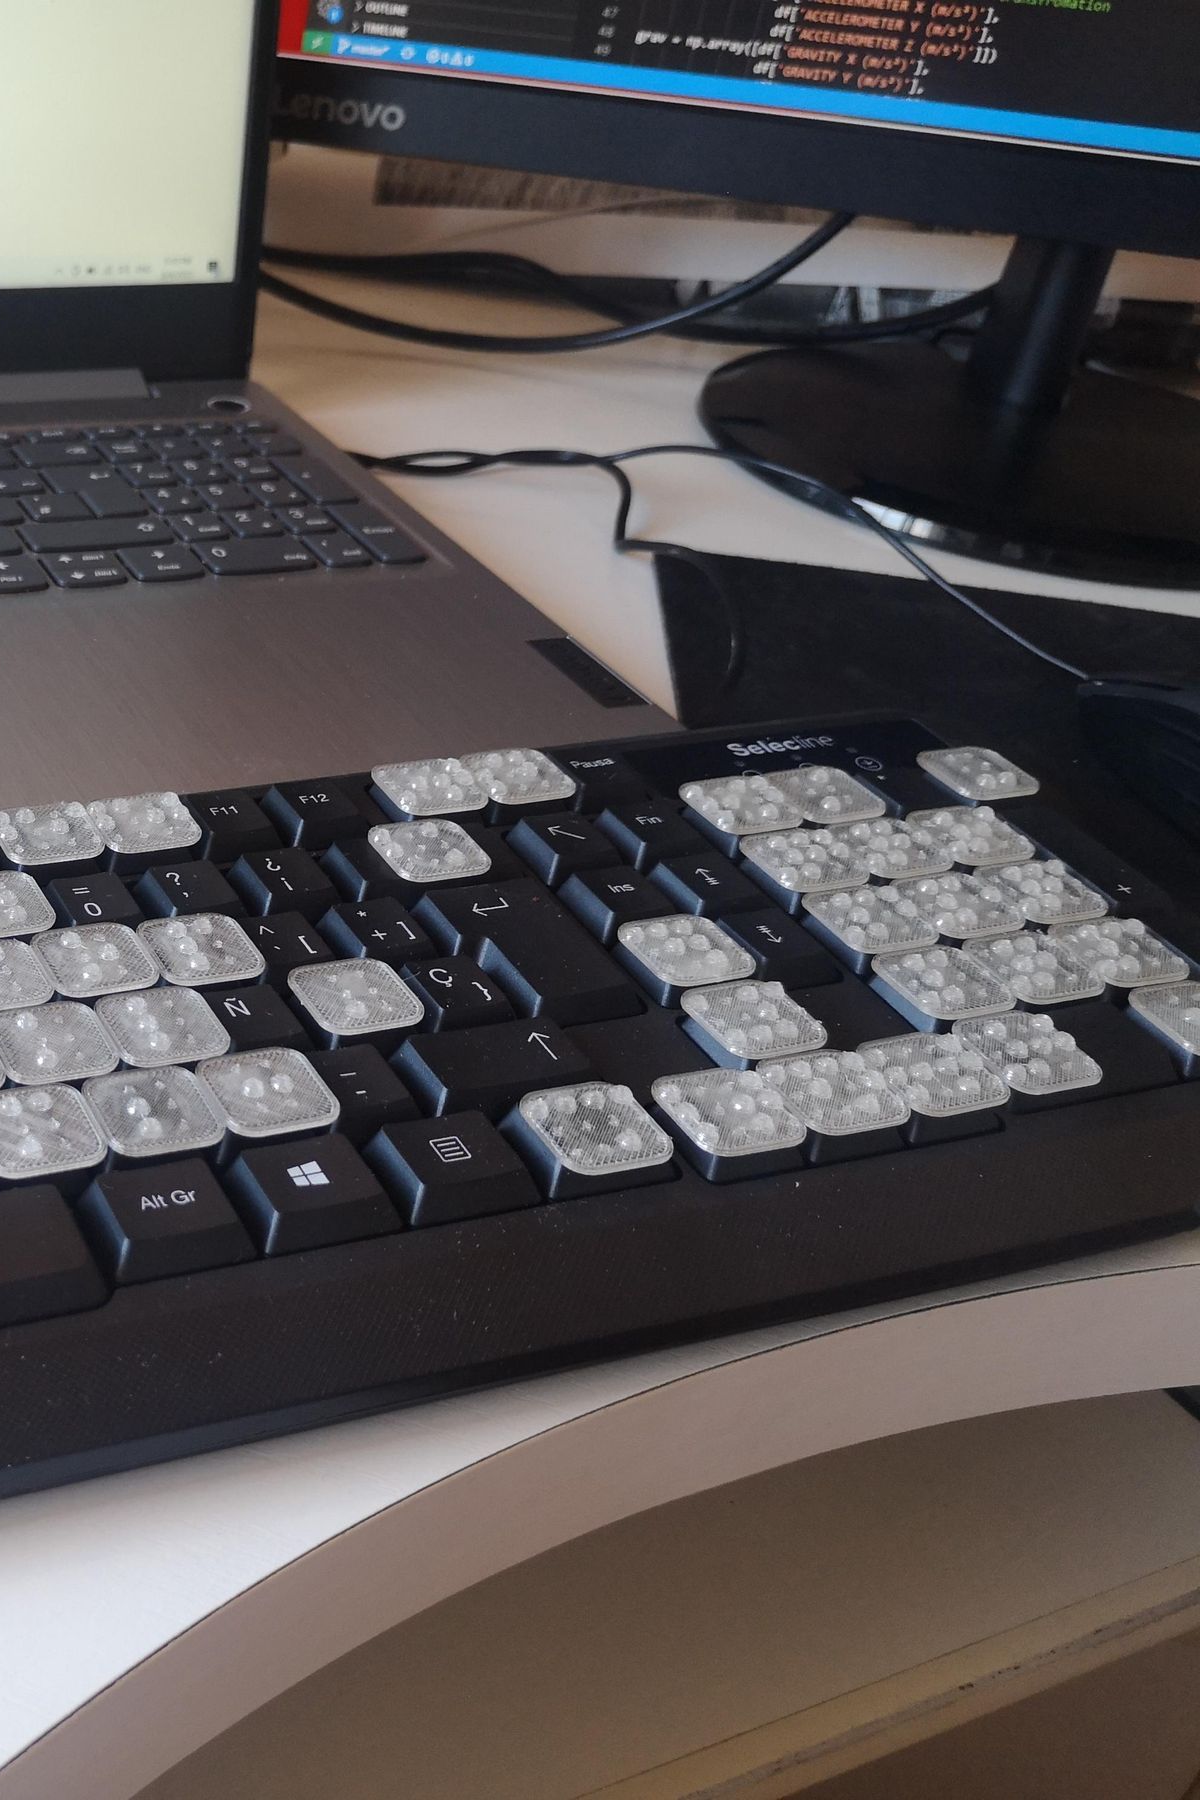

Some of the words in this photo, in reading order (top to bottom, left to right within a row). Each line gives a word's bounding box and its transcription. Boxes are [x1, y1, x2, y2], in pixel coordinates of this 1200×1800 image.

[726, 734, 833, 757] Selecline
[569, 757, 614, 769] Pausa
[299, 793, 330, 805] F12
[209, 805, 239, 816] F11
[635, 814, 662, 825] Fin
[607, 882, 635, 894] Ins
[84, 902, 102, 916] 0
[223, 997, 251, 1017] Ñ
[141, 1195, 168, 1211] Alt
[170, 1189, 196, 1204] Gr
